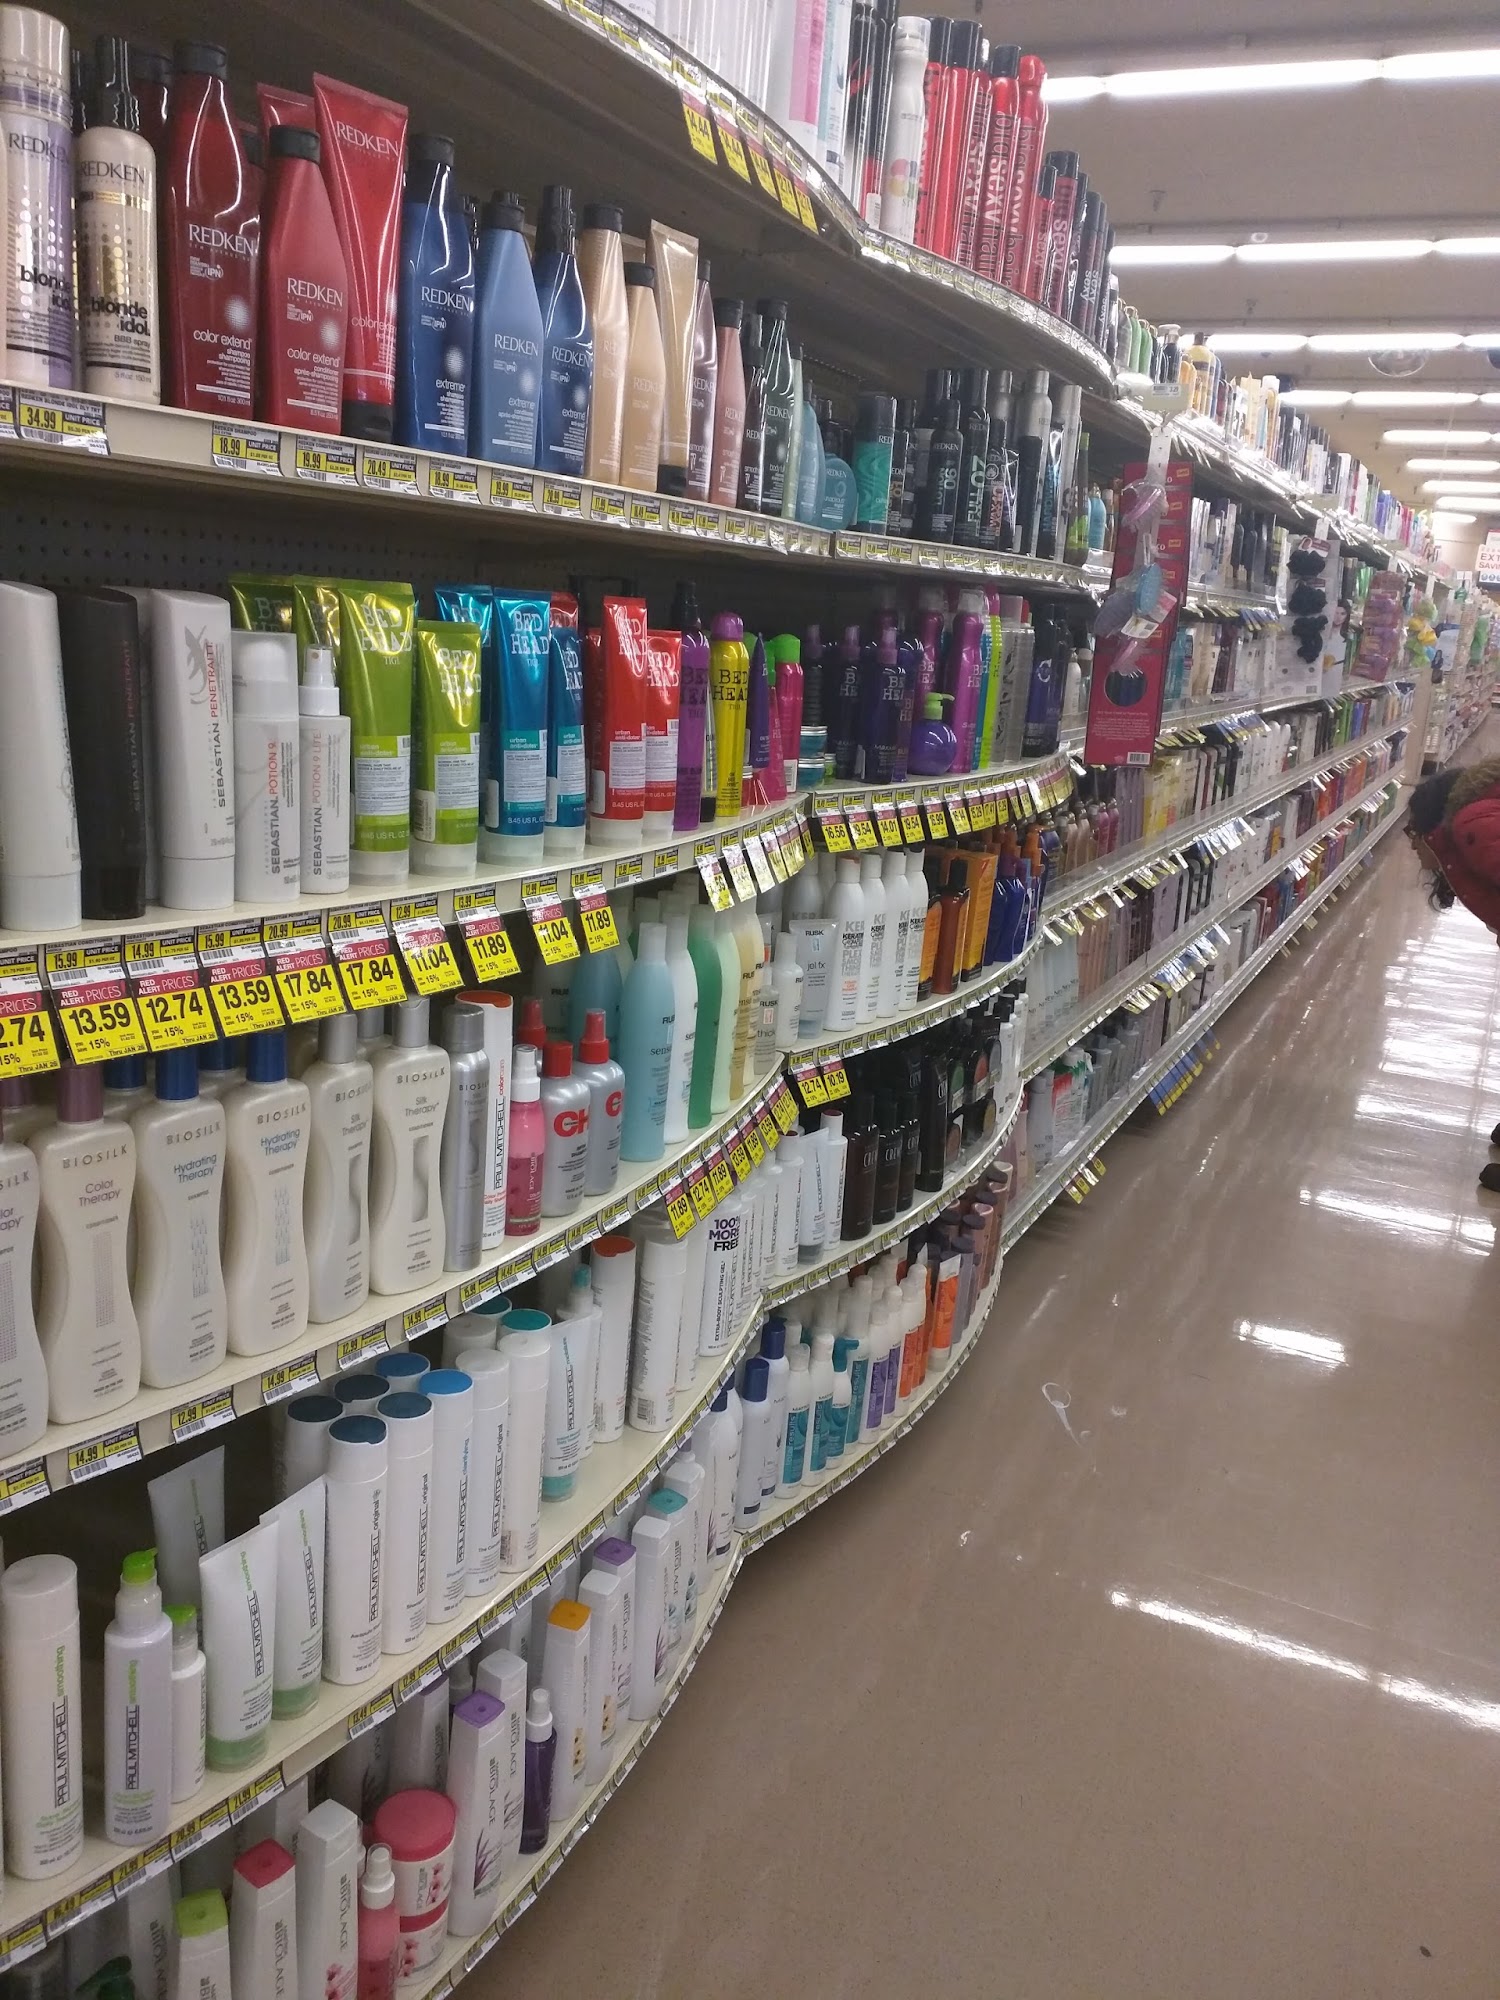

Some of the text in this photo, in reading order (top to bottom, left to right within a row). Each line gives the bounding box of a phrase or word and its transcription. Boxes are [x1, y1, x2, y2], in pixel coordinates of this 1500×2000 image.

[336, 120, 399, 157] REDKEN
[189, 223, 255, 256] REDKEN
[286, 278, 343, 307] REDKEN
[421, 287, 470, 311] REDKEN
[90, 297, 147, 319] blonde
[193, 328, 251, 350] color extend
[494, 333, 538, 357] REDKEN
[287, 347, 340, 367] color extend
[551, 346, 590, 367] REDKEN
[435, 378, 465, 392] extreme
[508, 398, 535, 410] extreme
[27, 406, 57, 430] 34.99
[64, 413, 101, 427] UNIT PRICE
[219, 436, 241, 456] 18.99
[302, 451, 321, 469] 19.99
[367, 460, 387, 476] 20.49
[1478, 561, 1500, 570] SAVI
[362, 603, 403, 629] BED
[513, 610, 543, 632] BED
[360, 629, 415, 654] HEAD
[511, 634, 550, 655] HEAD
[718, 669, 749, 684] BED
[205, 642, 226, 808] SEBASTIAN PENETRAITT
[311, 769, 322, 805] POTION
[268, 750, 281, 874] SEBASTIAN POTION
[824, 826, 847, 839] 16.56
[880, 821, 898, 834] 14.01
[313, 807, 322, 876] SEBASTIAN
[332, 914, 353, 932] 20.99
[585, 909, 611, 932] 11.89
[204, 932, 225, 950] 15.99
[268, 924, 289, 940] 20.99
[538, 922, 570, 944] 11.04
[86, 945, 120, 957] UNIT PRICE
[131, 942, 155, 960] 14.99
[358, 942, 387, 958] PRICES
[472, 934, 508, 961] 11.89
[53, 951, 79, 971] 15.99
[276, 957, 291, 966] RED
[276, 963, 295, 973] ALERT
[295, 953, 324, 968] PRICES
[413, 944, 451, 974] 11.04
[210, 973, 232, 984] ALERT
[211, 967, 227, 976] RED
[232, 960, 264, 980] PRICES
[346, 959, 395, 988] 17.84
[138, 986, 161, 997] ALERT
[139, 979, 156, 988] RED
[161, 976, 196, 991] PRICES
[283, 967, 333, 999] 17.84
[60, 996, 85, 1008] ALERT
[61, 989, 79, 999] RED
[85, 988, 122, 1003] PRICES
[218, 979, 271, 1011] 13.59
[361, 988, 379, 999] 15%
[146, 990, 204, 1024] 12.74
[301, 999, 318, 1011] 15%
[68, 1002, 131, 1036] 13.59
[235, 1012, 254, 1025] 15%
[163, 1026, 185, 1038] 15%
[196, 1034, 209, 1042] JAN
[88, 1037, 111, 1050] 15%
[108, 1046, 137, 1058] Thru JAN
[18, 1062, 49, 1073] Thru JAN
[396, 1068, 446, 1085] BIOSILK
[801, 1077, 822, 1093] 12.74
[827, 1073, 846, 1087] 10.19
[404, 1102, 438, 1117] Therapy
[415, 1096, 428, 1106] Silk
[256, 1102, 308, 1126] BIOSILK
[166, 1120, 222, 1146] BIOSILK
[496, 1097, 506, 1158] MITCHELL
[260, 1128, 302, 1148] Hydrating
[62, 1143, 129, 1170] BIOSILK
[264, 1139, 299, 1157] Therapy
[174, 1154, 218, 1176] Hydrating
[178, 1166, 216, 1184] Therapy
[493, 1159, 505, 1193] PAUL
[85, 1178, 115, 1194] Color
[692, 1181, 710, 1198] 12.74
[79, 1188, 121, 1208] Therapy
[670, 1197, 689, 1219] 11.89
[342, 1338, 360, 1354] 12.99
[266, 1371, 286, 1389] 14.99
[178, 1407, 197, 1426] 12.99
[496, 1423, 505, 1454] original
[75, 1446, 99, 1467] 14.99
[55, 1644, 70, 1807] PAUL MITCHELL smoothing
[127, 1706, 140, 1790] PAUL MITCHELL
[233, 1788, 251, 1809] 21.99
